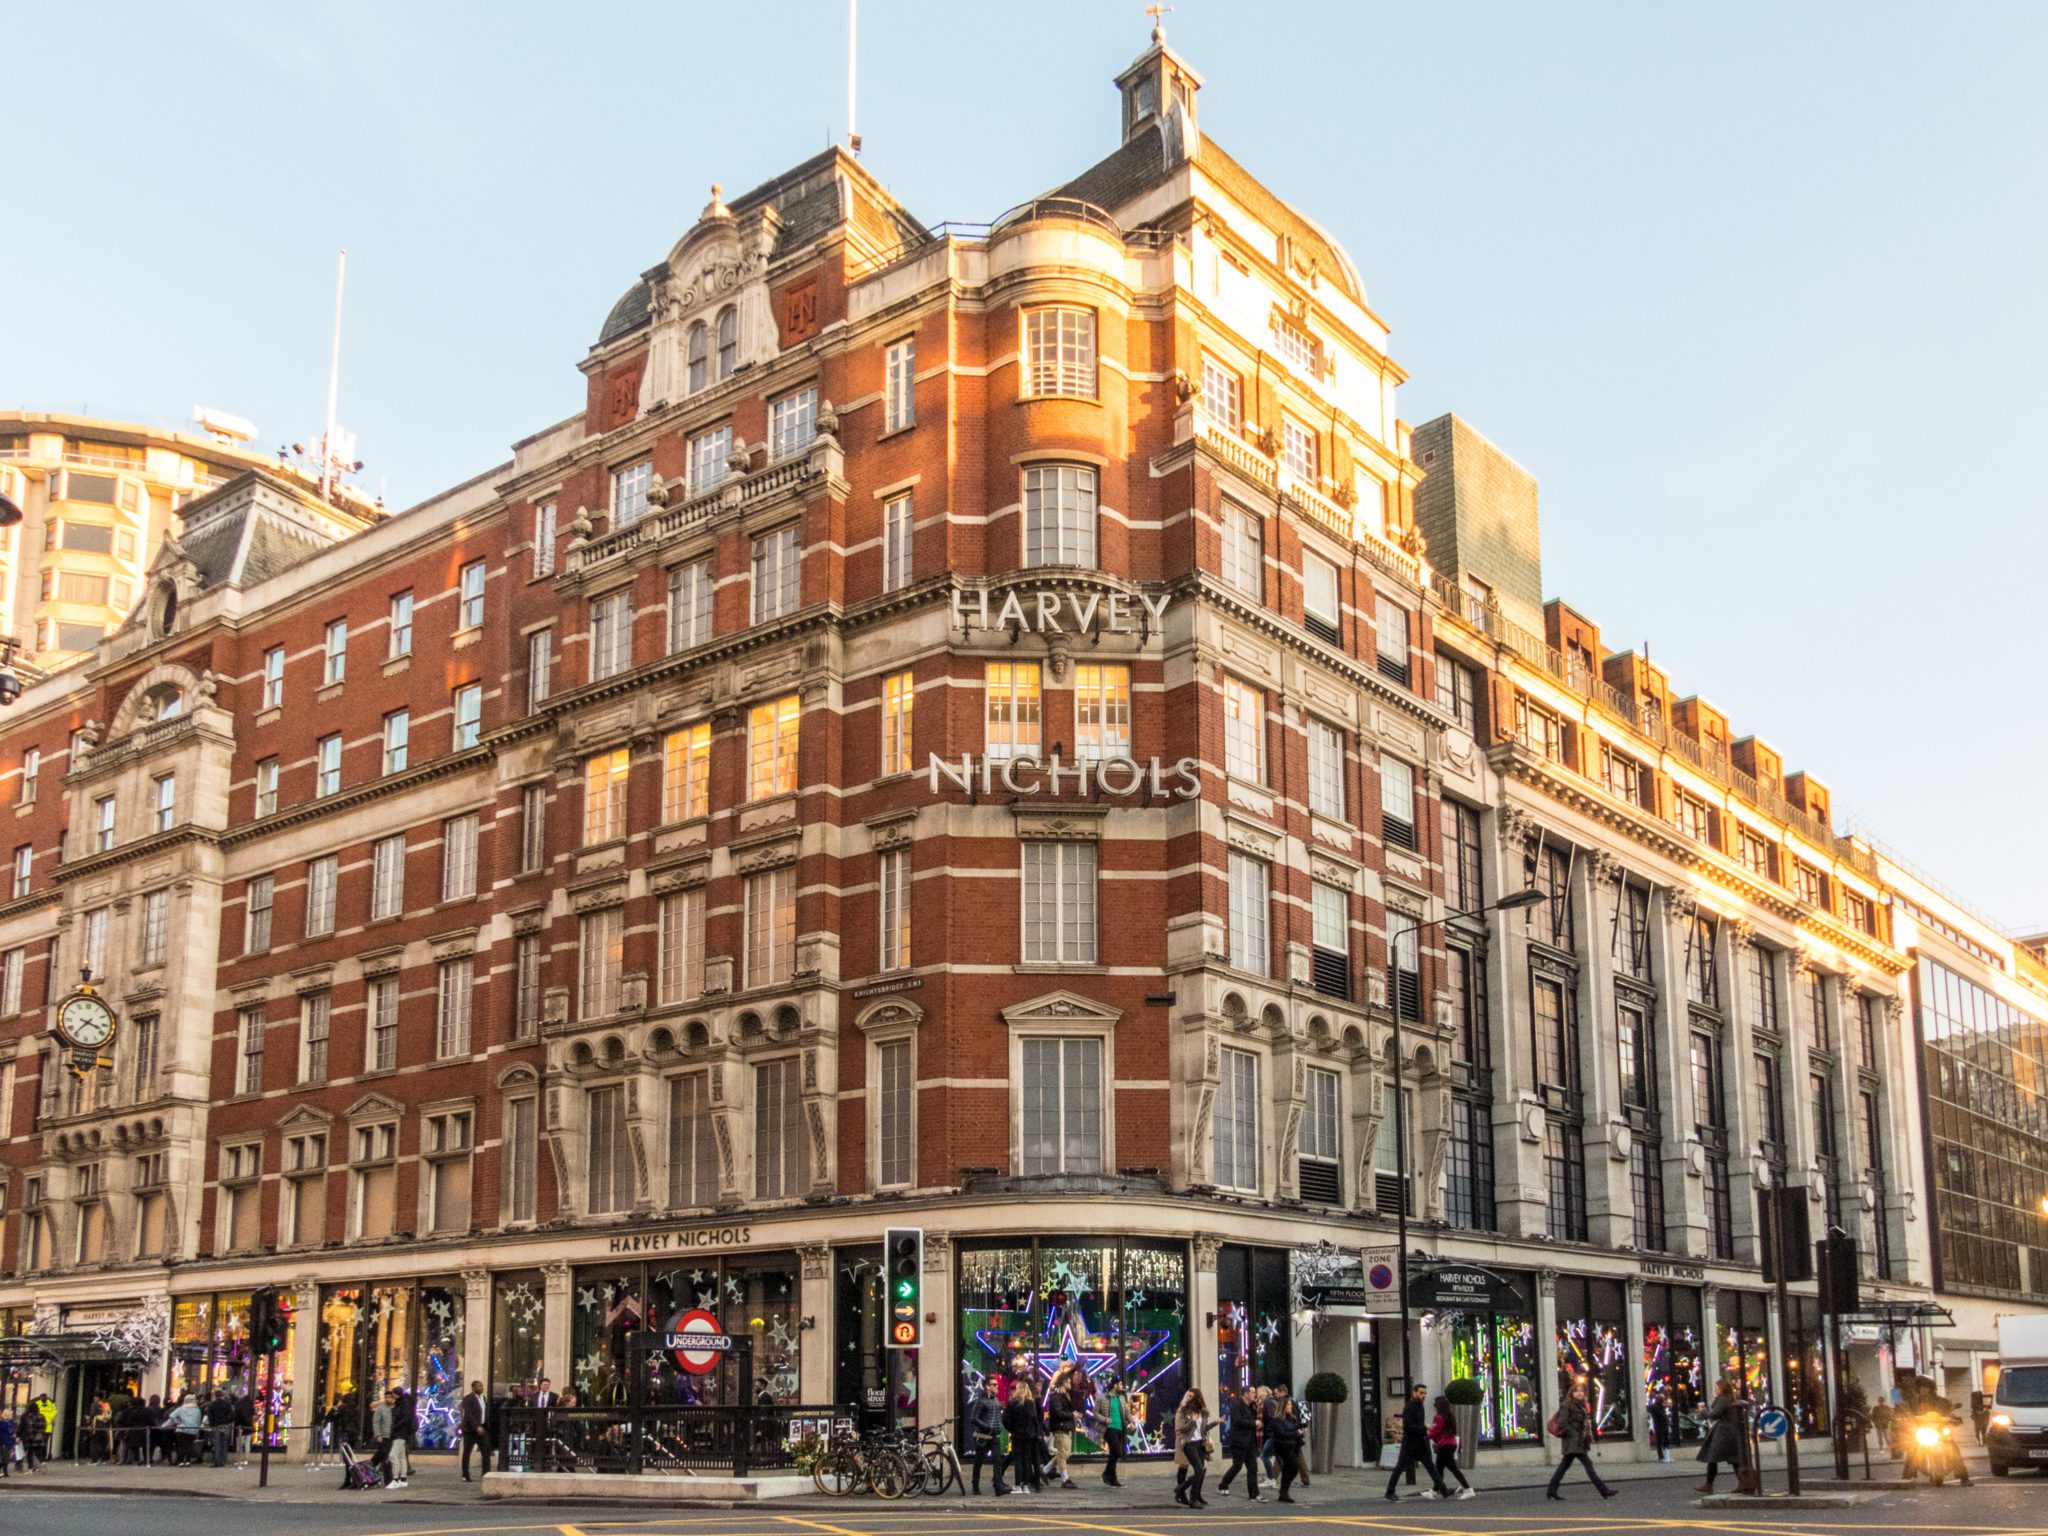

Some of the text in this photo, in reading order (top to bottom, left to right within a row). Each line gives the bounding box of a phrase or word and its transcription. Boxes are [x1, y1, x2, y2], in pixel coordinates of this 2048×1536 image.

[952, 588, 1171, 635] HARVEY
[929, 752, 1201, 799] NICHOLS
[610, 1227, 750, 1252] HARVEY NICHOLS
[1369, 1255, 1392, 1263] ZONE
[1439, 1273, 1486, 1285] HARVEY NICHOLS
[1641, 1262, 1704, 1280] HARVEY NICHOLS
[666, 1334, 732, 1350] UNDERGROUND
[867, 1387, 886, 1396] floral
